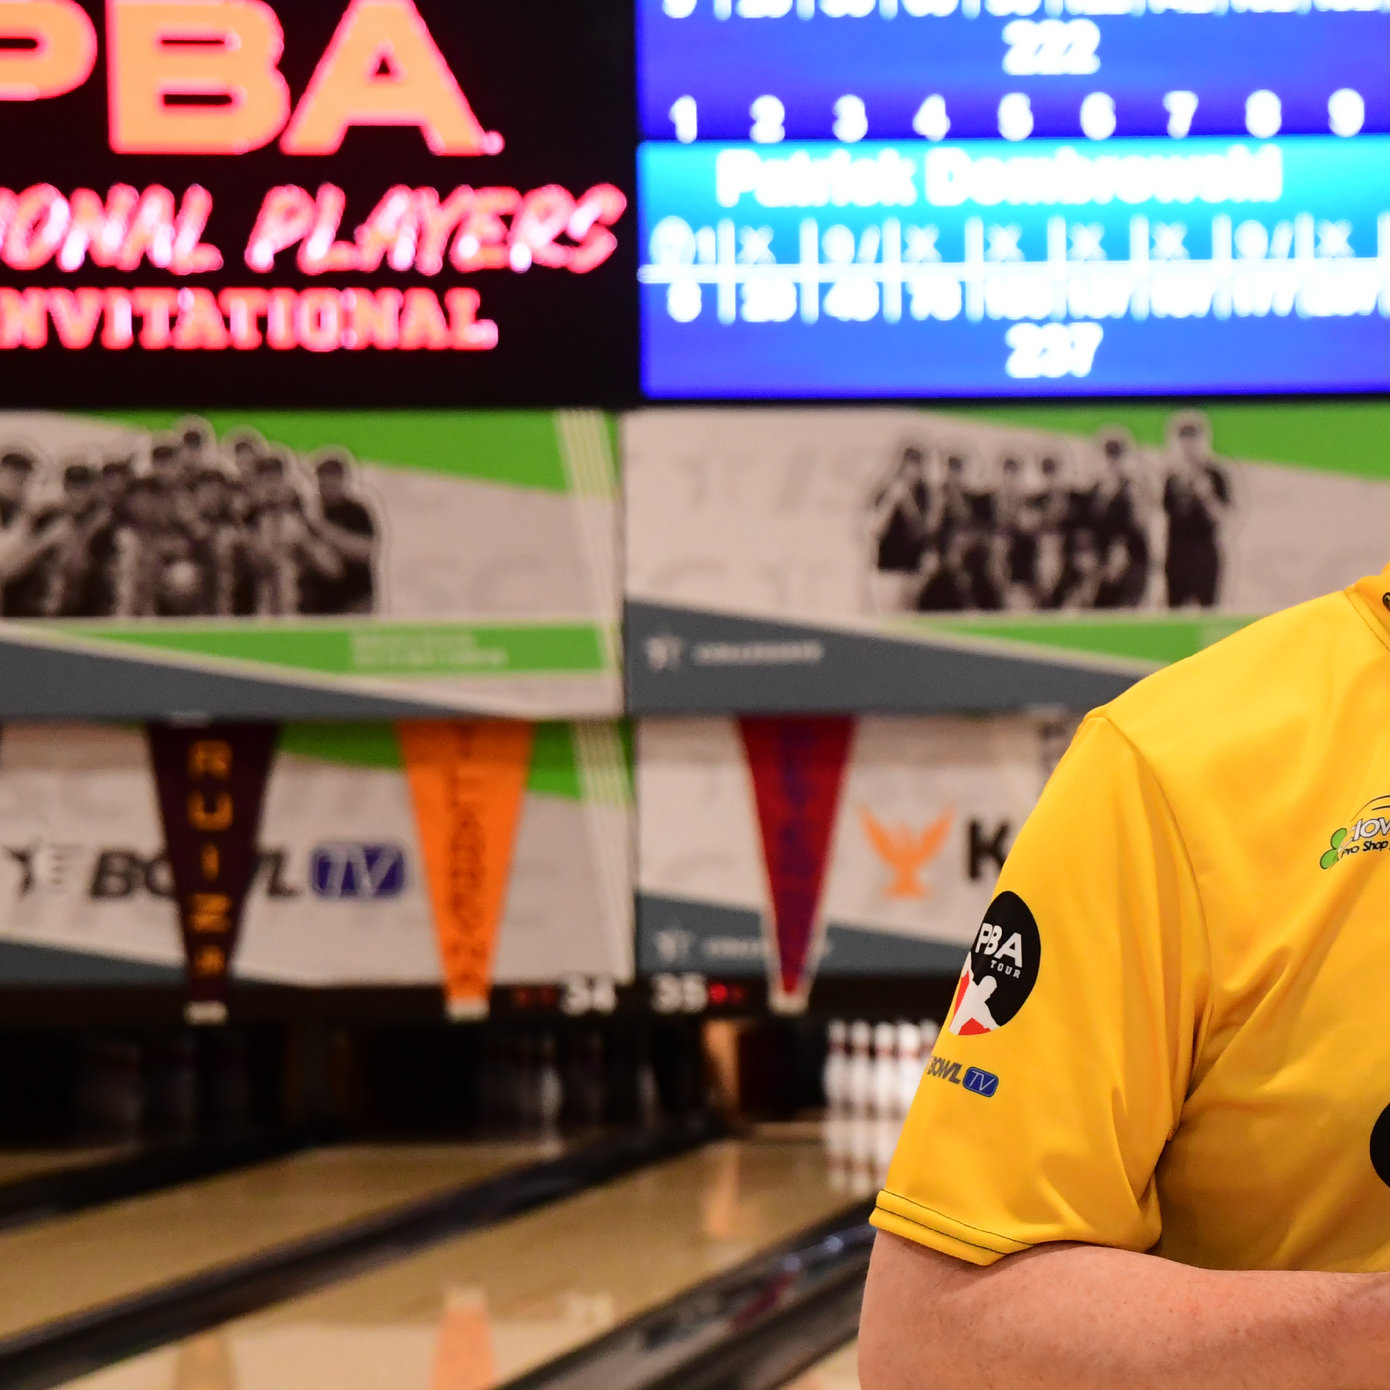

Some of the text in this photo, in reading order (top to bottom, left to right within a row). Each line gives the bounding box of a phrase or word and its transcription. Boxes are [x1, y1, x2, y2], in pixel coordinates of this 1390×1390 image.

[1003, 18, 1101, 75] 222
[1163, 90, 1199, 139] 7
[245, 183, 627, 273] PLAYERS
[1362, 840, 1389, 852] Shop
[975, 922, 1023, 968] PBA
[990, 959, 1021, 979] TOUR
[969, 1070, 996, 1092] TV
